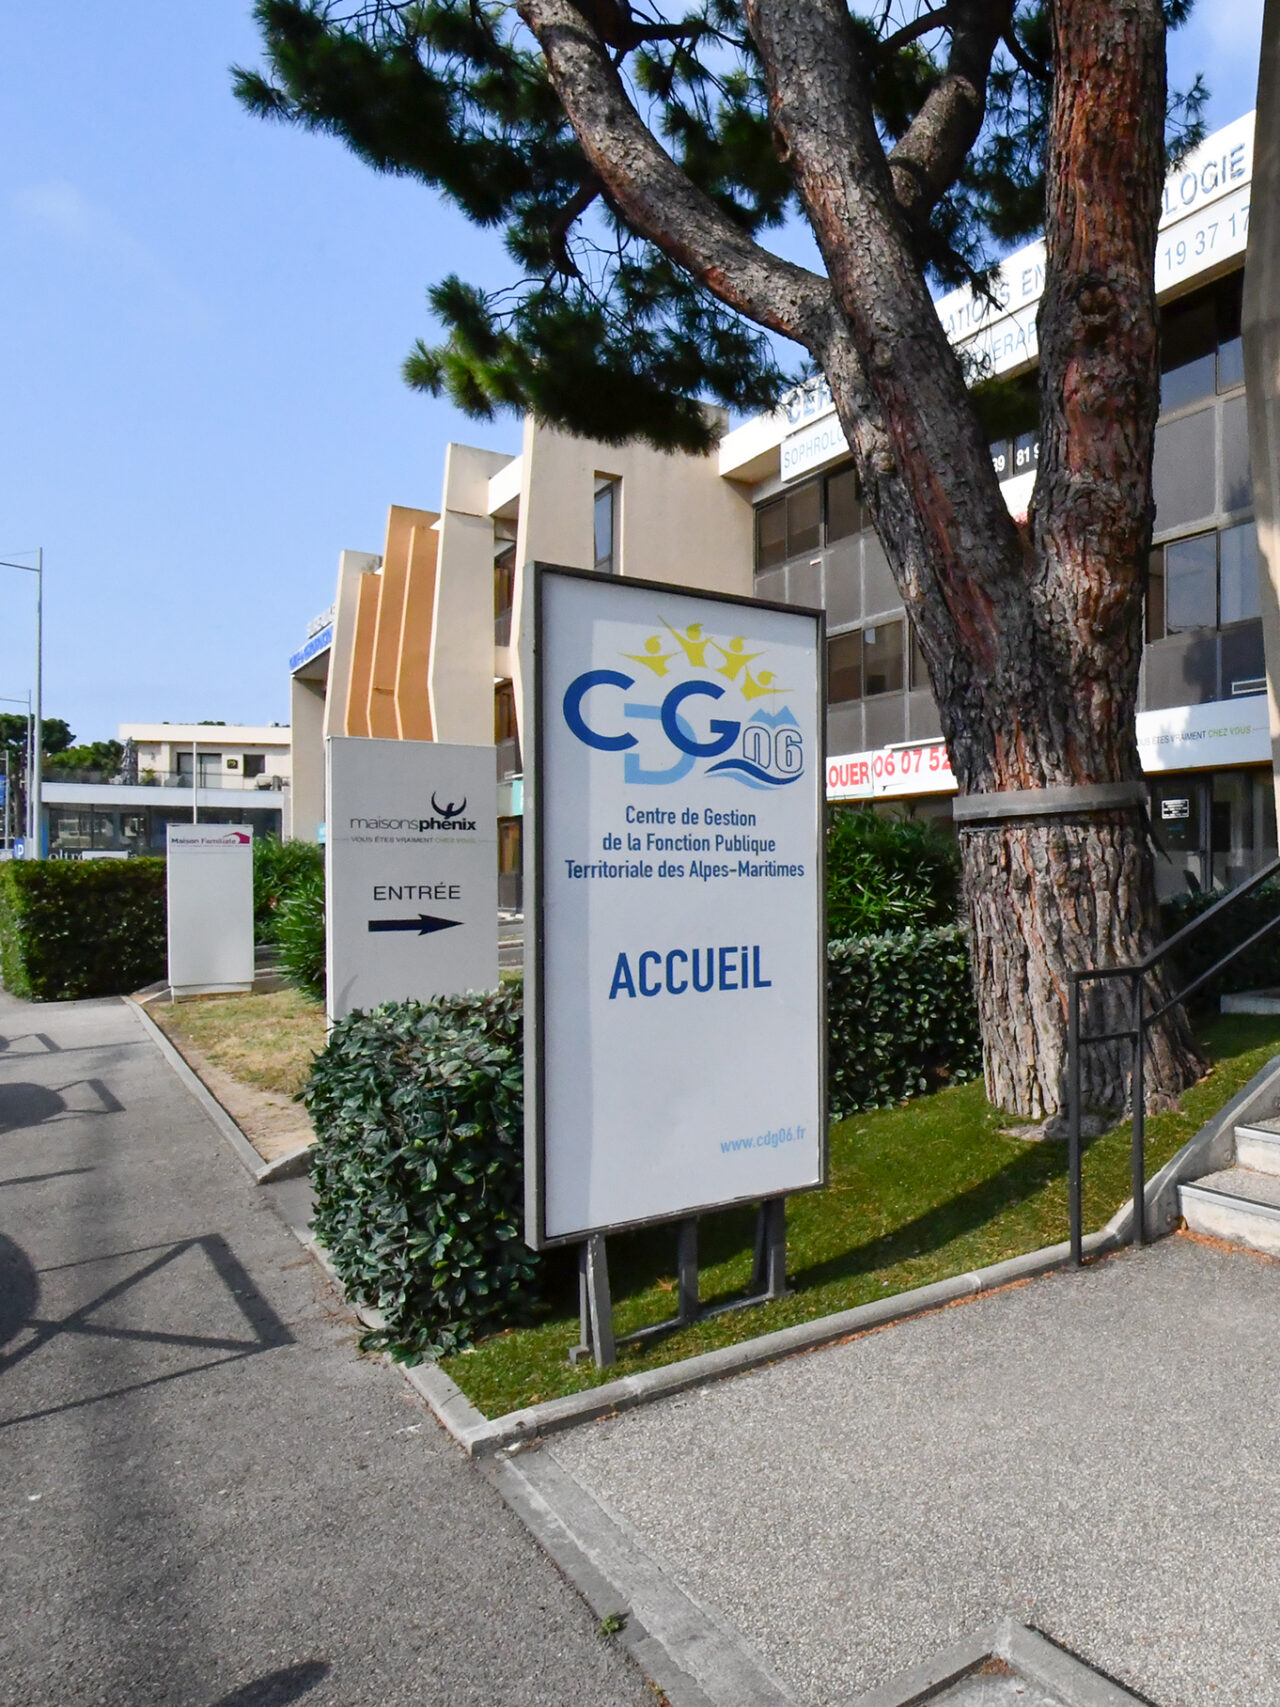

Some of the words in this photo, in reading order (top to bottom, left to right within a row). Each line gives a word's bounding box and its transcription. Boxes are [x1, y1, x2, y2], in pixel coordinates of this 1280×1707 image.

[1164, 143, 1246, 215] LOGIE
[1165, 240, 1187, 271] 19
[1195, 222, 1219, 256] 37
[1016, 446, 1030, 466] 81
[826, 761, 871, 789] OUER
[873, 754, 896, 778] 06
[901, 749, 924, 774] 07
[625, 805, 676, 825] Centre
[681, 807, 699, 826] de
[703, 808, 757, 827] Gestion
[602, 832, 622, 851] de
[627, 832, 641, 851] la
[646, 833, 710, 852] Fonction
[715, 834, 776, 856] Publique
[564, 860, 653, 879] Territoriale
[658, 860, 685, 878] des
[689, 860, 805, 882] Alpes-Maritimes
[373, 882, 461, 901] ENTRÉE
[719, 1125, 807, 1154] www.cdg06.fr
